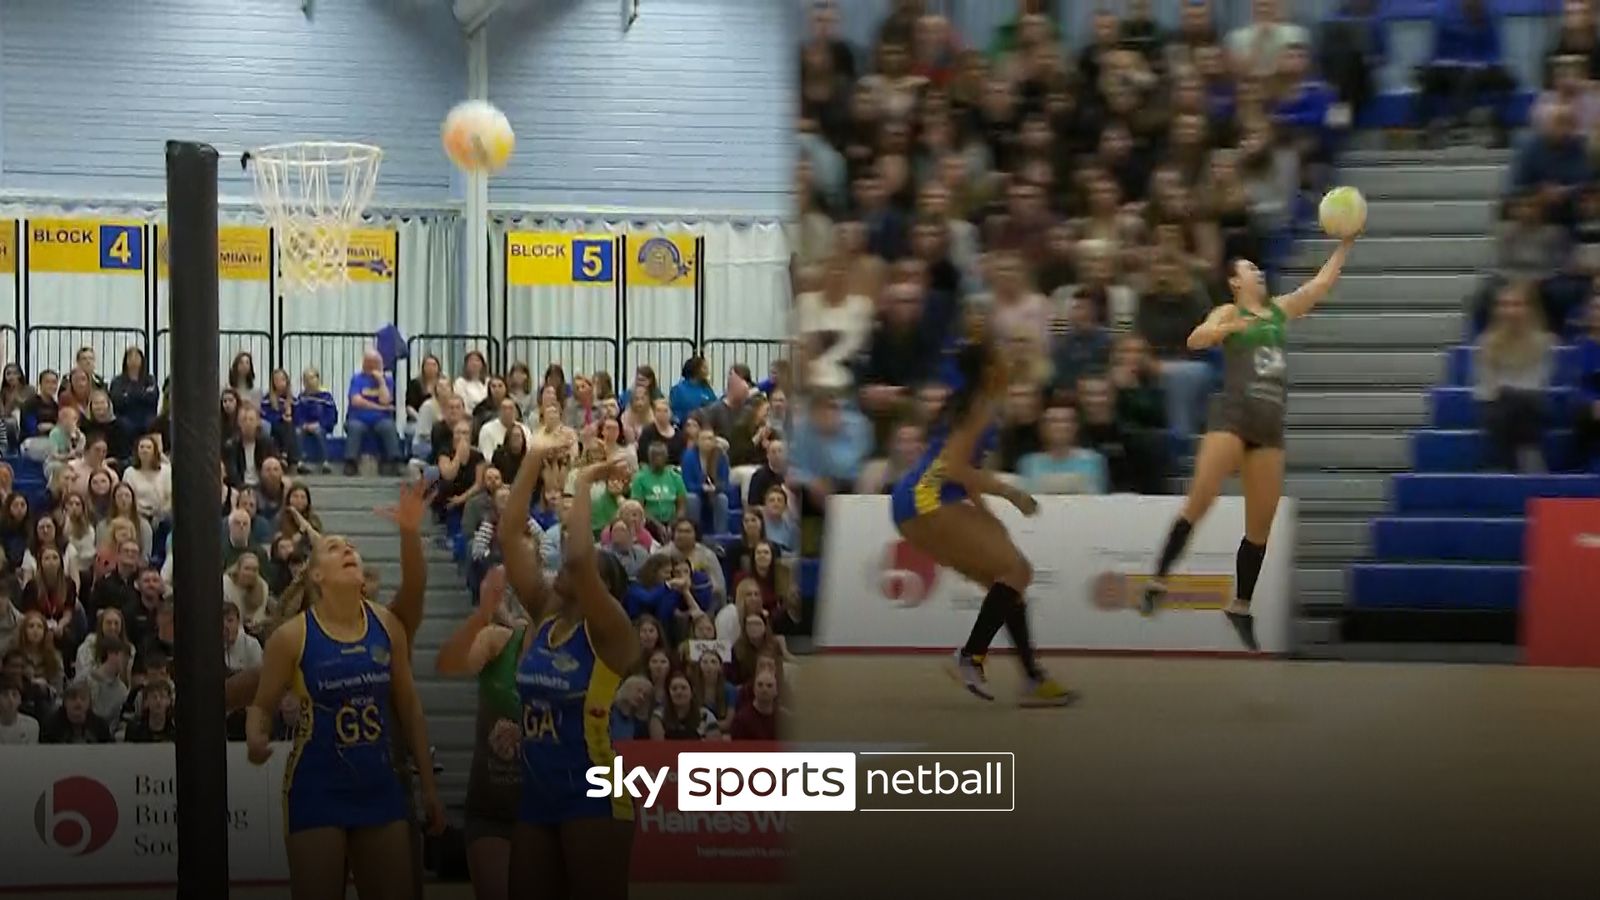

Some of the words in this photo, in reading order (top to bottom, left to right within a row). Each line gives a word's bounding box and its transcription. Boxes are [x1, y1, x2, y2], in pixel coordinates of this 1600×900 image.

[33, 228, 94, 244] BLOCK
[109, 230, 132, 264] 4
[510, 243, 567, 258] BLOCK
[582, 245, 603, 277] 5
[335, 704, 382, 743] GS
[523, 704, 560, 744] GA
[135, 774, 176, 796] Bat
